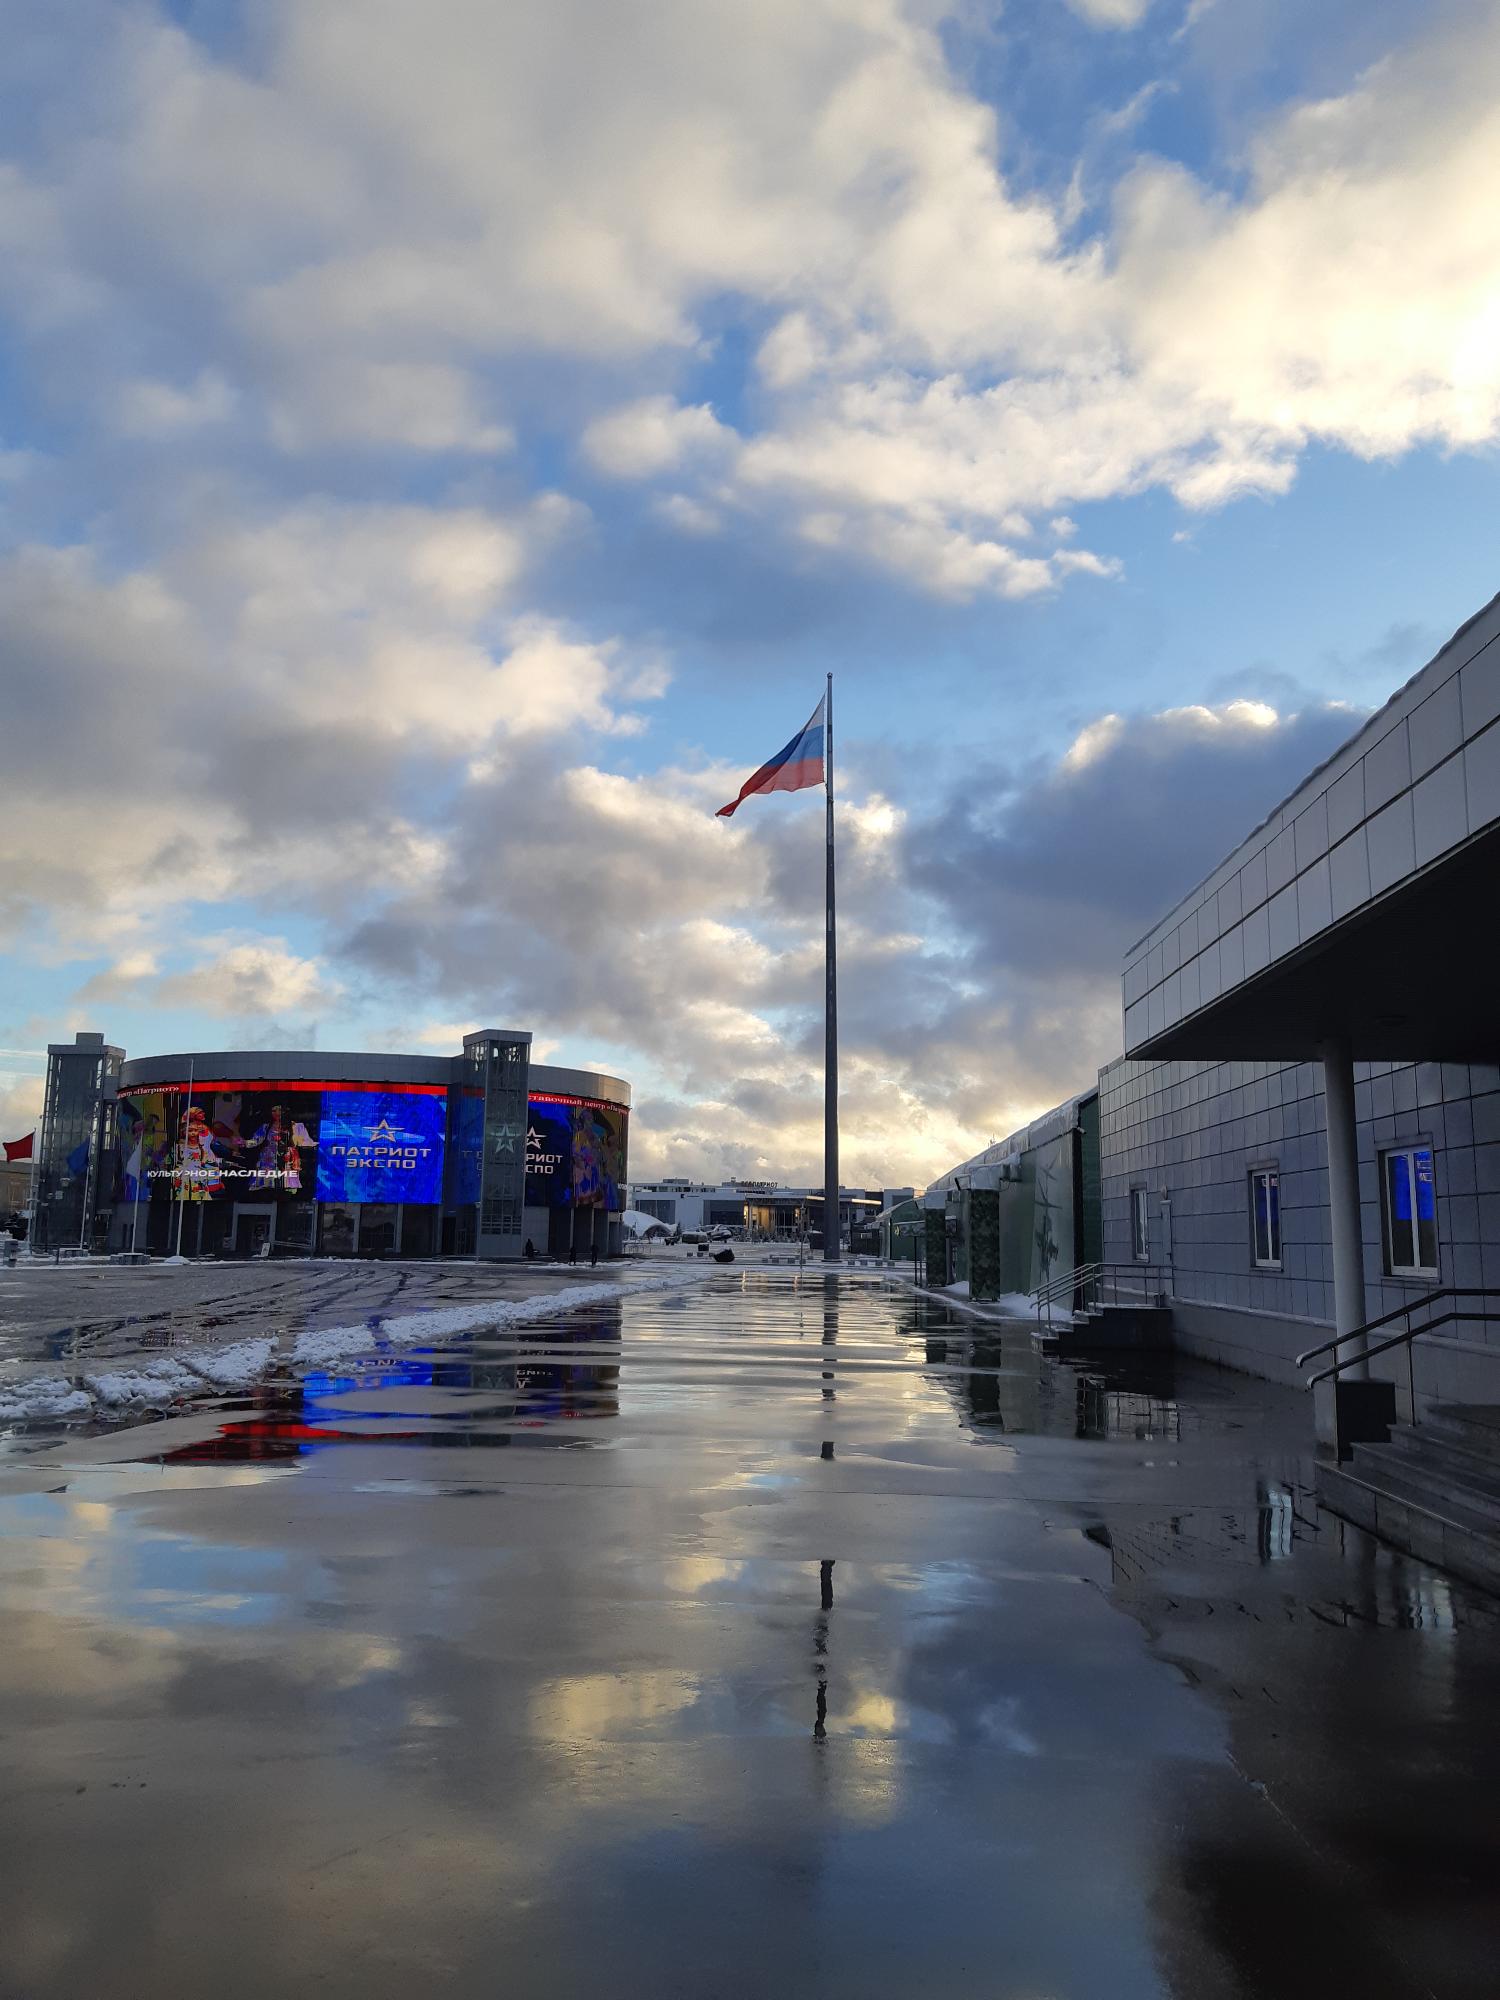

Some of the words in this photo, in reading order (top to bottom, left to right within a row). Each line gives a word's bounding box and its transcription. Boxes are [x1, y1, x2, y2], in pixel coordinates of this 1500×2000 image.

[332, 1146, 432, 1158] ПАТРИОТ
[346, 1158, 416, 1169] ЭКСПО
[525, 1153, 564, 1164] РИОТ
[219, 1169, 299, 1179] НАСЛЕДИЕ
[525, 1164, 554, 1175] СПО
